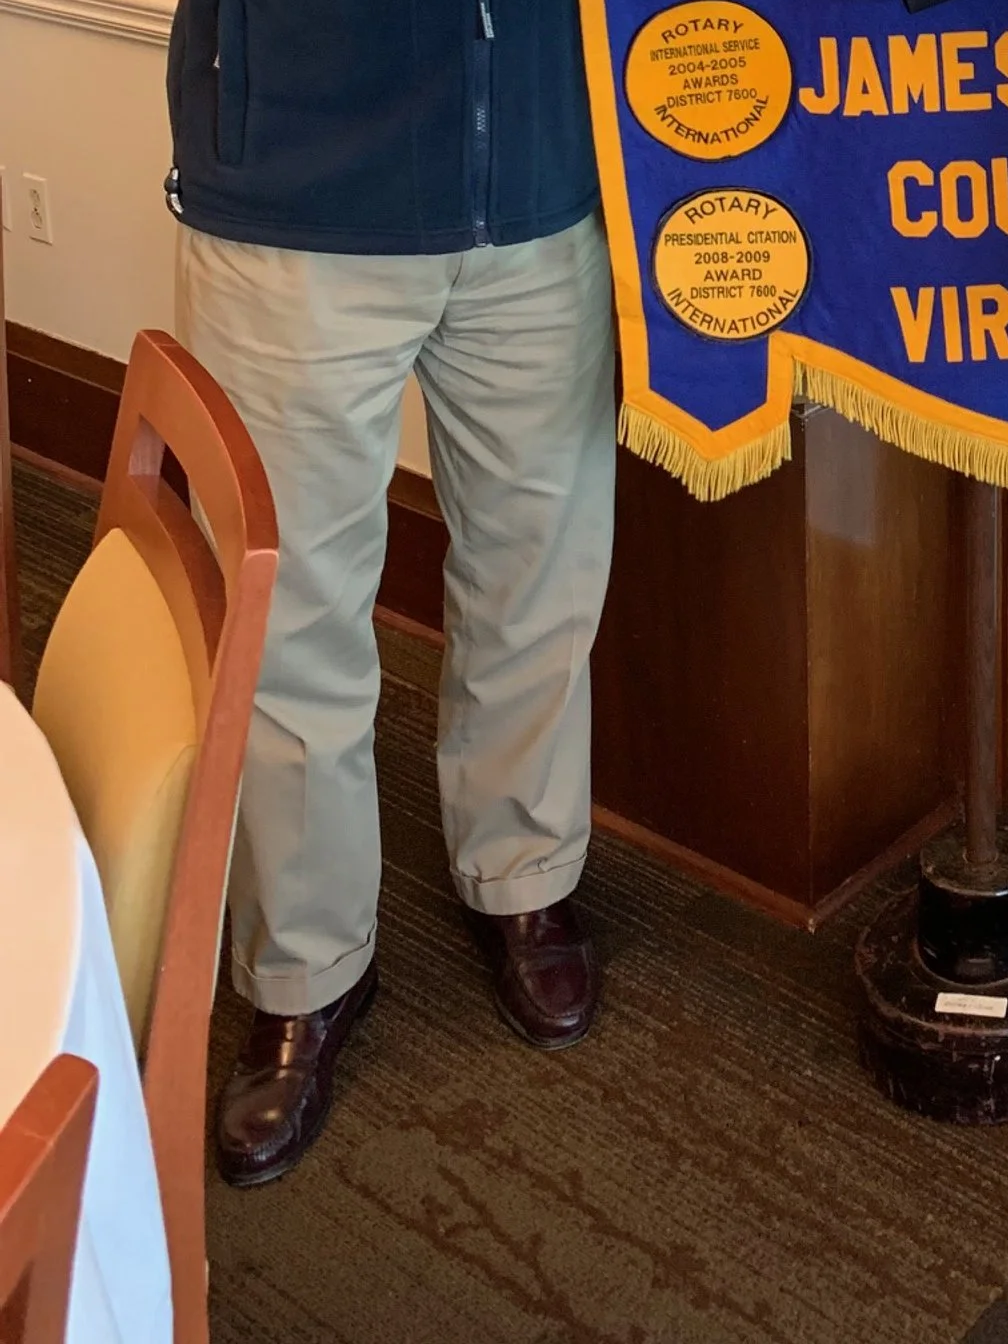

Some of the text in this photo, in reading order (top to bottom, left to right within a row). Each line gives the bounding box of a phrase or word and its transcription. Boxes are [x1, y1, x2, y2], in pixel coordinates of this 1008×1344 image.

[661, 18, 744, 45] ROTARY
[650, 37, 760, 62] INTERNATIONAL SERVICE
[668, 56, 747, 76] 2004-2005
[683, 73, 739, 90] AWARDS
[666, 87, 757, 108] DISTRICT 7600
[654, 94, 770, 144] INTERNATIONAL
[684, 196, 778, 225] ROTARY
[664, 230, 797, 246] PRESIDENTIAL CITATION
[694, 251, 770, 265] 2008-2009
[704, 268, 762, 282] AWARD
[690, 285, 777, 299] DISTRICT 7600
[667, 287, 799, 334] INTERNATIONAL
